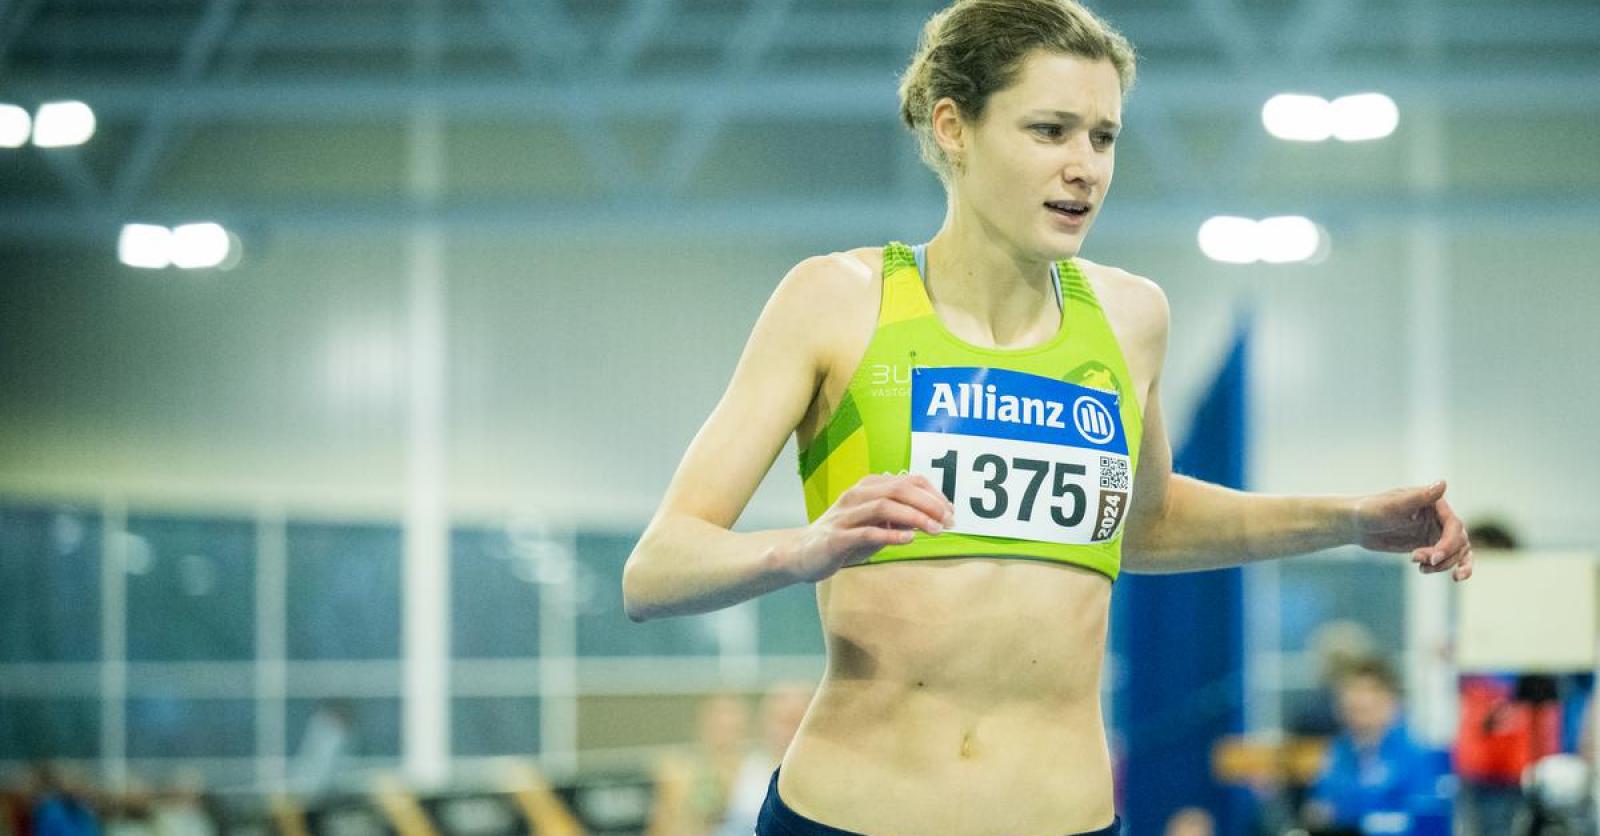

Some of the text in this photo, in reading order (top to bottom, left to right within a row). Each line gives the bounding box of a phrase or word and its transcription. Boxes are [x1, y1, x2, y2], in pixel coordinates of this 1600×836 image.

[871, 364, 914, 385] BU
[926, 383, 1065, 429] Allianz
[931, 450, 1087, 528] 1375
[1097, 494, 1121, 539] 2024
